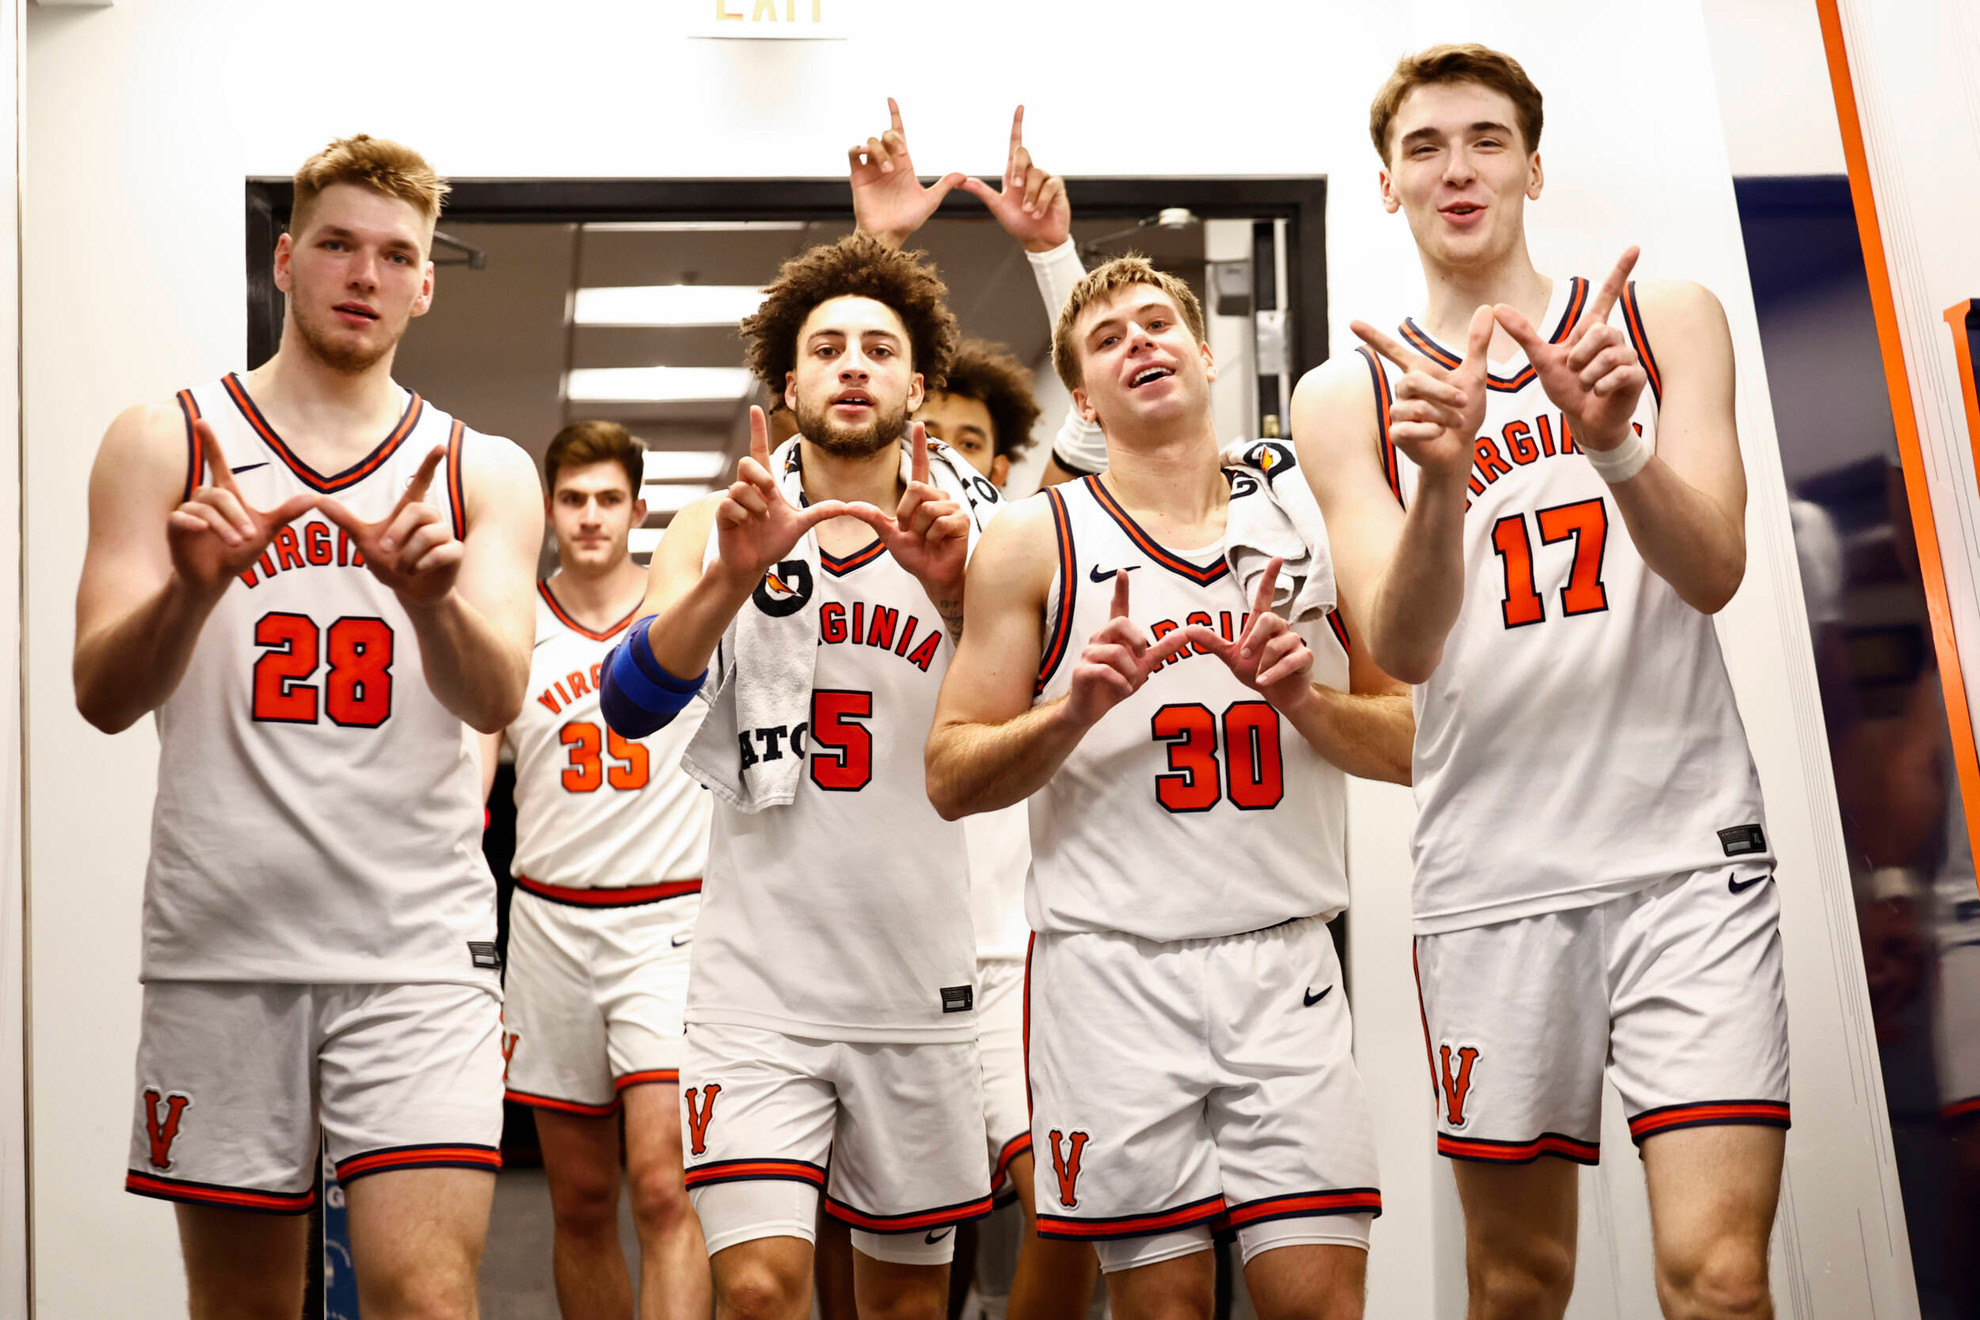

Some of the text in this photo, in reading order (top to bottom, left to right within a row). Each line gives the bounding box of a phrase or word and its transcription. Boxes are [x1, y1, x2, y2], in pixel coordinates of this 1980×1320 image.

[1491, 497, 1609, 629] 17
[252, 611, 394, 728] 28
[818, 602, 942, 672] GINIA
[560, 722, 649, 793] 35
[811, 689, 872, 791] 5
[1151, 700, 1284, 813] 30
[685, 1084, 721, 1155] V
[1440, 1045, 1479, 1125] V
[143, 1090, 189, 1168] V
[1049, 1130, 1089, 1207] V
